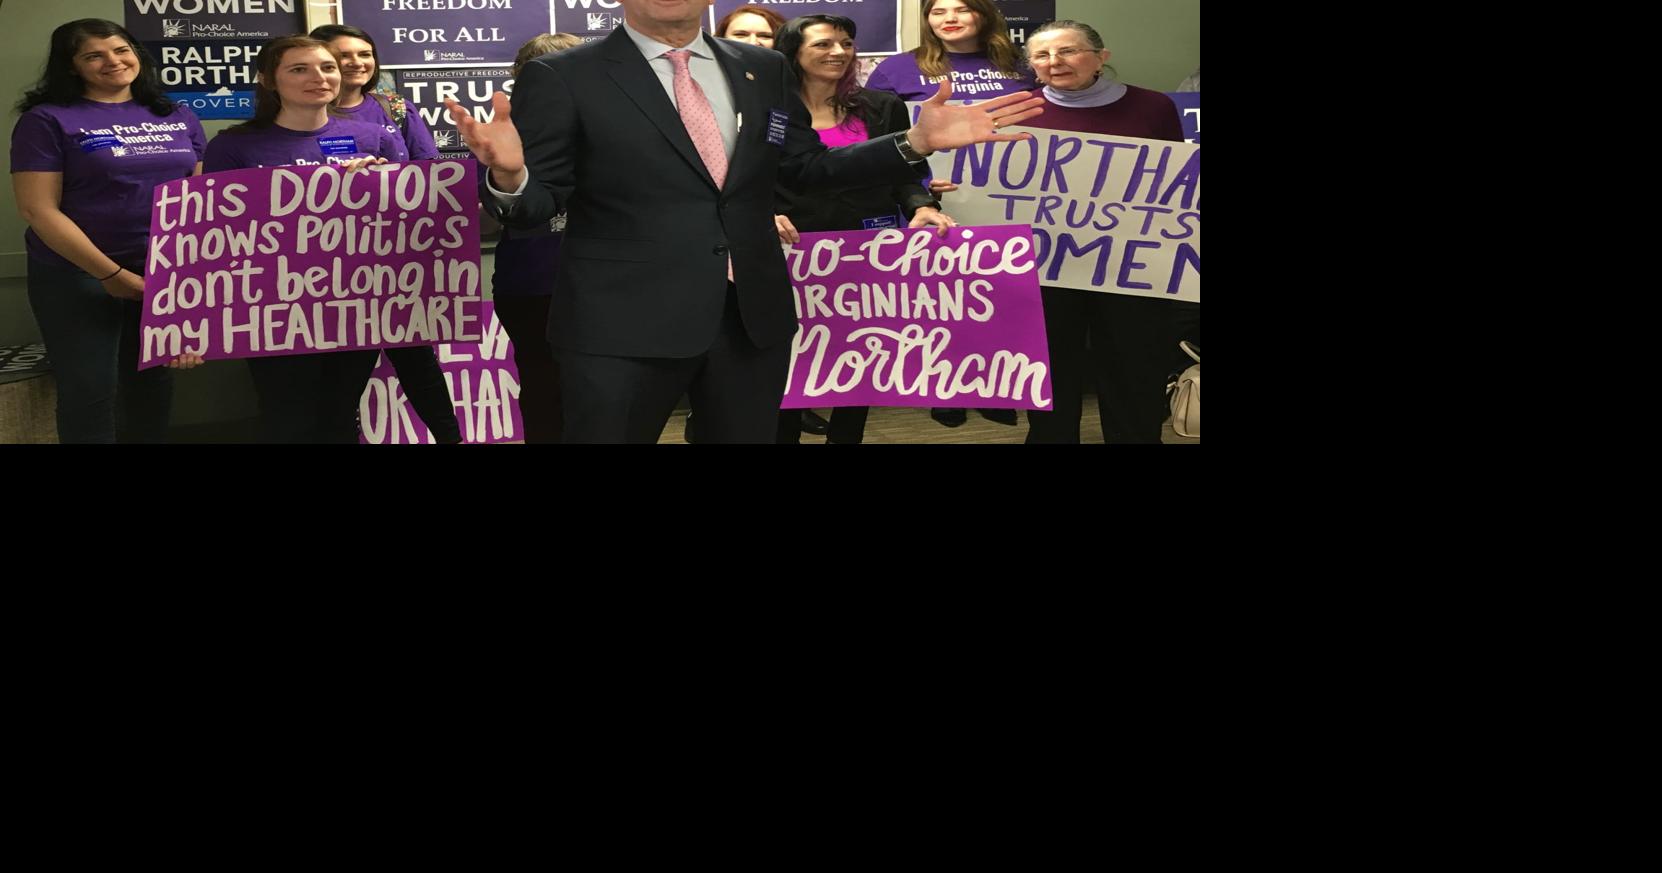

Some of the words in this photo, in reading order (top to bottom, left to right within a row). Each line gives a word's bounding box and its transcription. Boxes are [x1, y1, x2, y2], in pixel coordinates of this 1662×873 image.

[134, 0, 295, 14] WOMEN
[392, 27, 448, 43] FOR
[454, 27, 505, 42] ALL
[162, 46, 262, 64] RALPH
[161, 66, 258, 86] ORTH
[112, 121, 187, 134] Pro-Choice
[115, 132, 173, 144] America
[156, 178, 248, 231] this
[270, 162, 466, 217] DOCTOR
[988, 194, 1200, 239] TRUSTS
[151, 260, 264, 315] don't
[277, 256, 425, 306] belong
[433, 250, 479, 296] in
[142, 318, 209, 363] my
[222, 296, 480, 354] HEALTHCARE
[784, 323, 1051, 408] Northam
